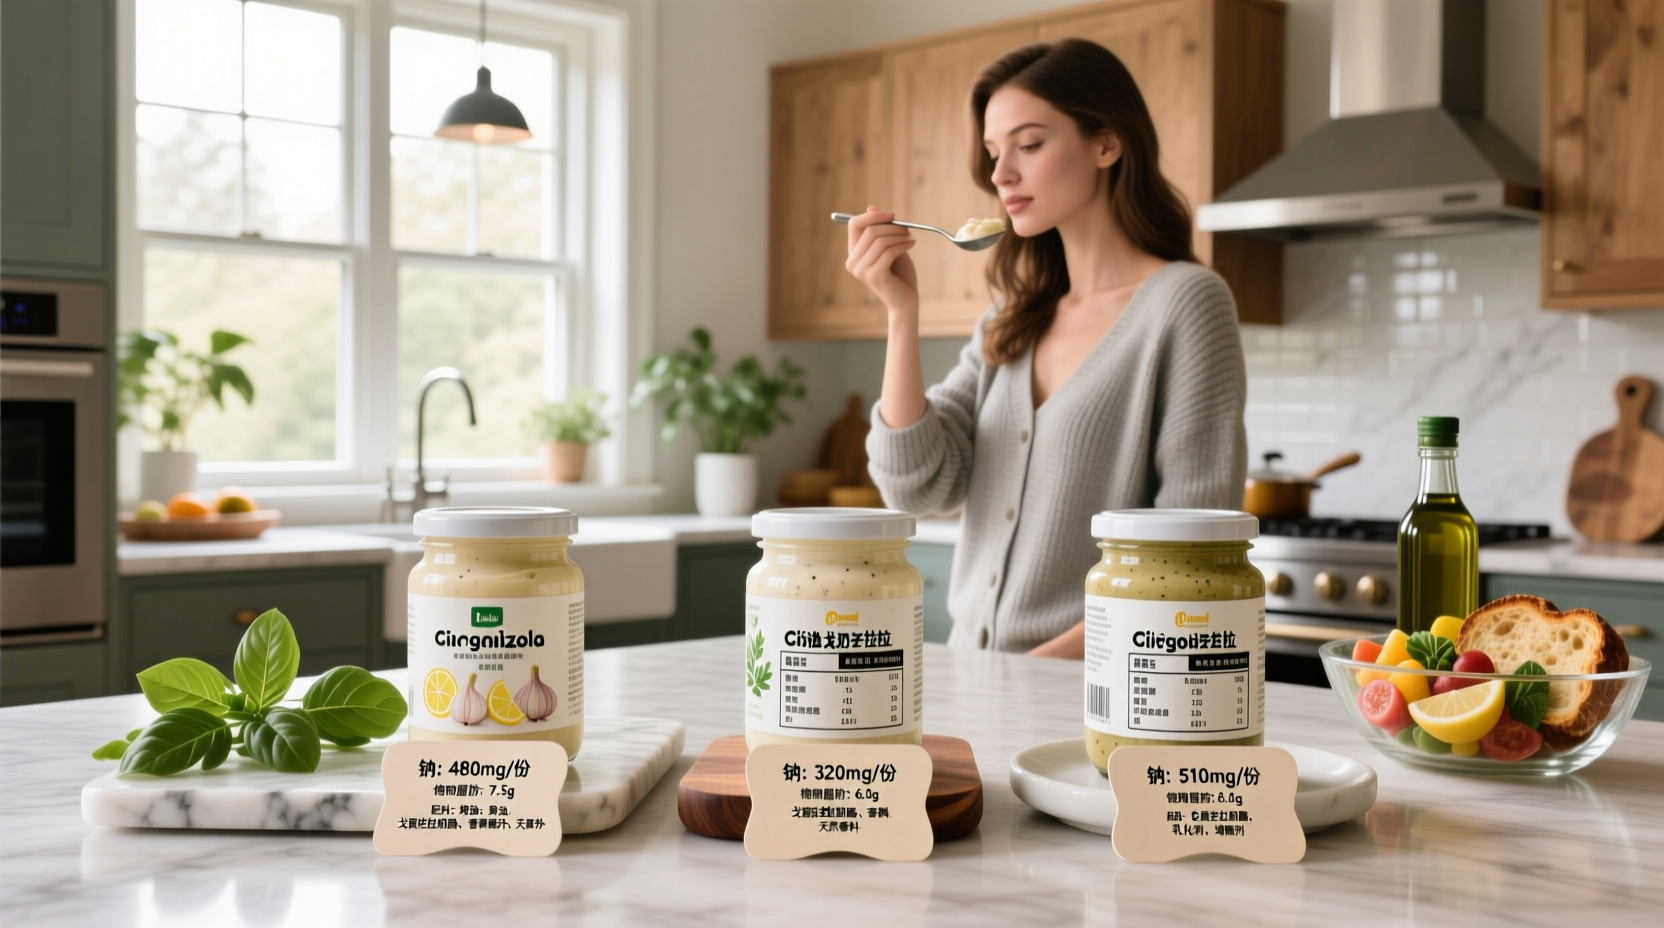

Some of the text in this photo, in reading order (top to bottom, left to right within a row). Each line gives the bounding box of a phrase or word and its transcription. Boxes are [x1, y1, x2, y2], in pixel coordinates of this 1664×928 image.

[418, 758, 531, 781] 钠: 480mg/份
[783, 762, 897, 784] 钠: 320mg/份
[1147, 765, 1260, 788] 钠: 510mg/份
